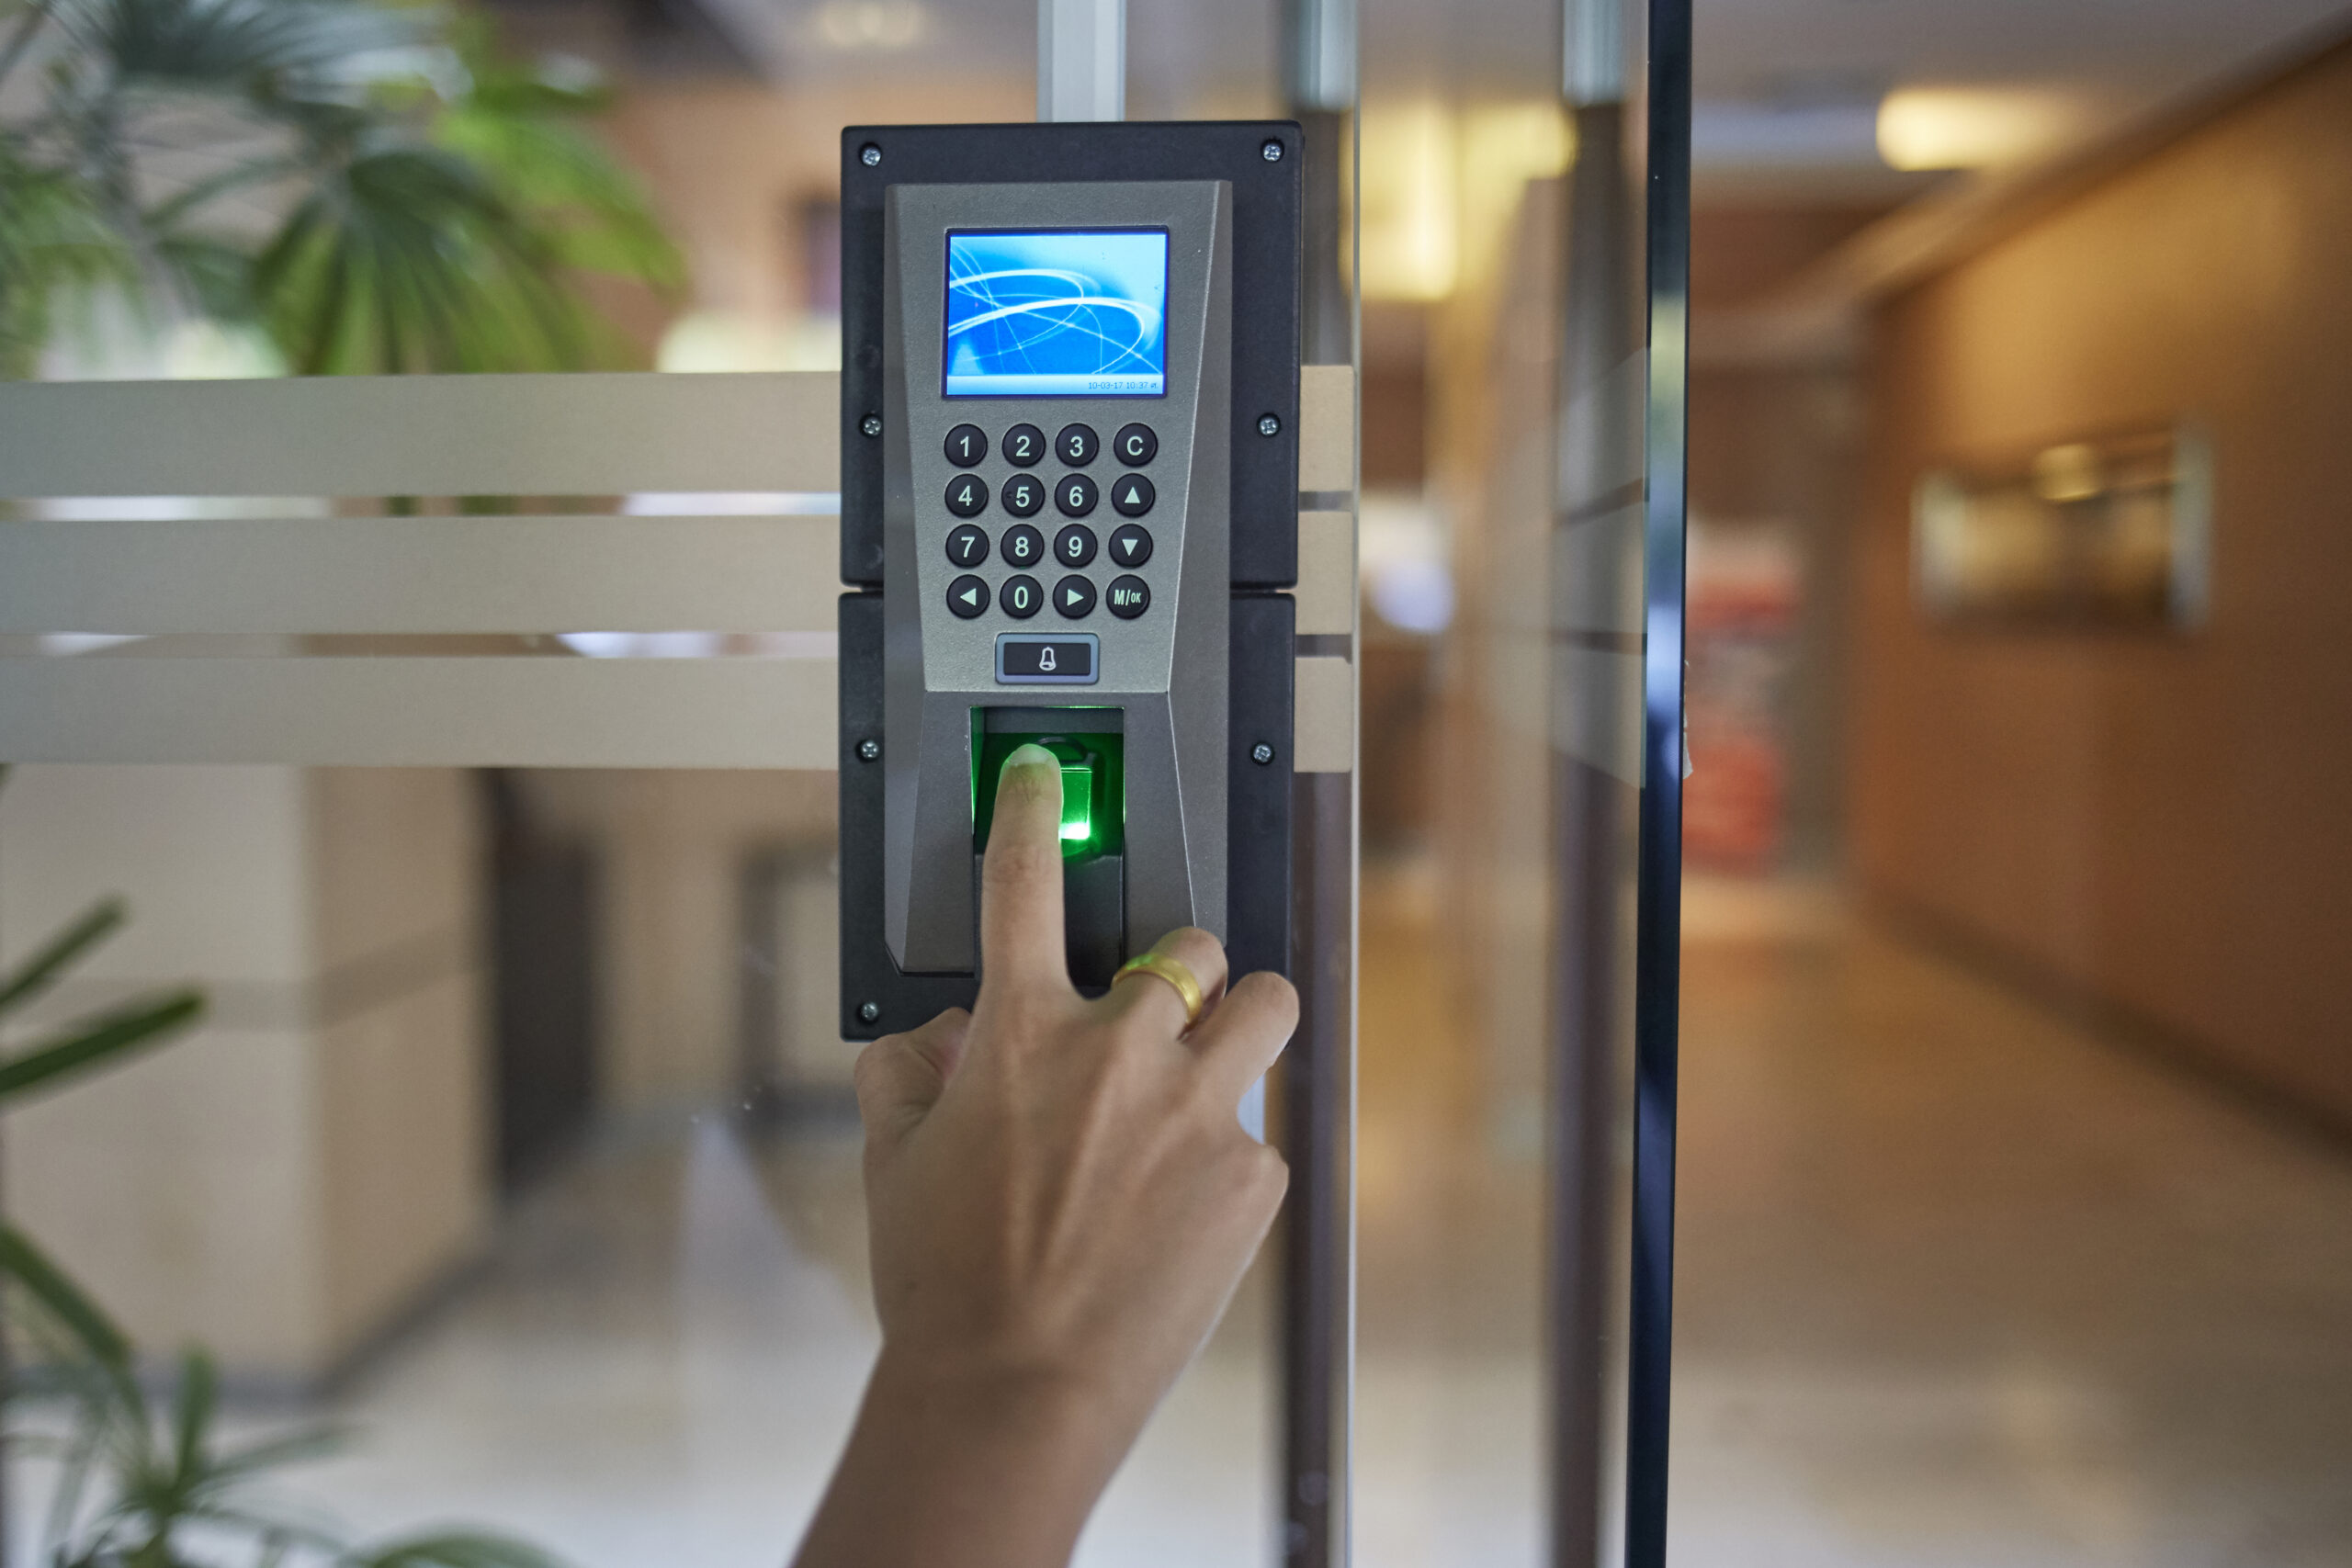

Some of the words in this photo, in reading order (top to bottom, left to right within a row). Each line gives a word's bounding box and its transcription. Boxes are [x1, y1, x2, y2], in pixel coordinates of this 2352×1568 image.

[959, 435, 969, 457] 1
[1016, 435, 1030, 457] 2
[1070, 436, 1083, 457] 3
[1127, 436, 1143, 456] C
[958, 485, 972, 506] 4
[1016, 487, 1029, 507] 5
[1069, 486, 1082, 506] 6
[961, 536, 975, 558] 7
[1015, 536, 1029, 557] 8
[1069, 536, 1082, 557] 9
[1014, 586, 1028, 608] 0
